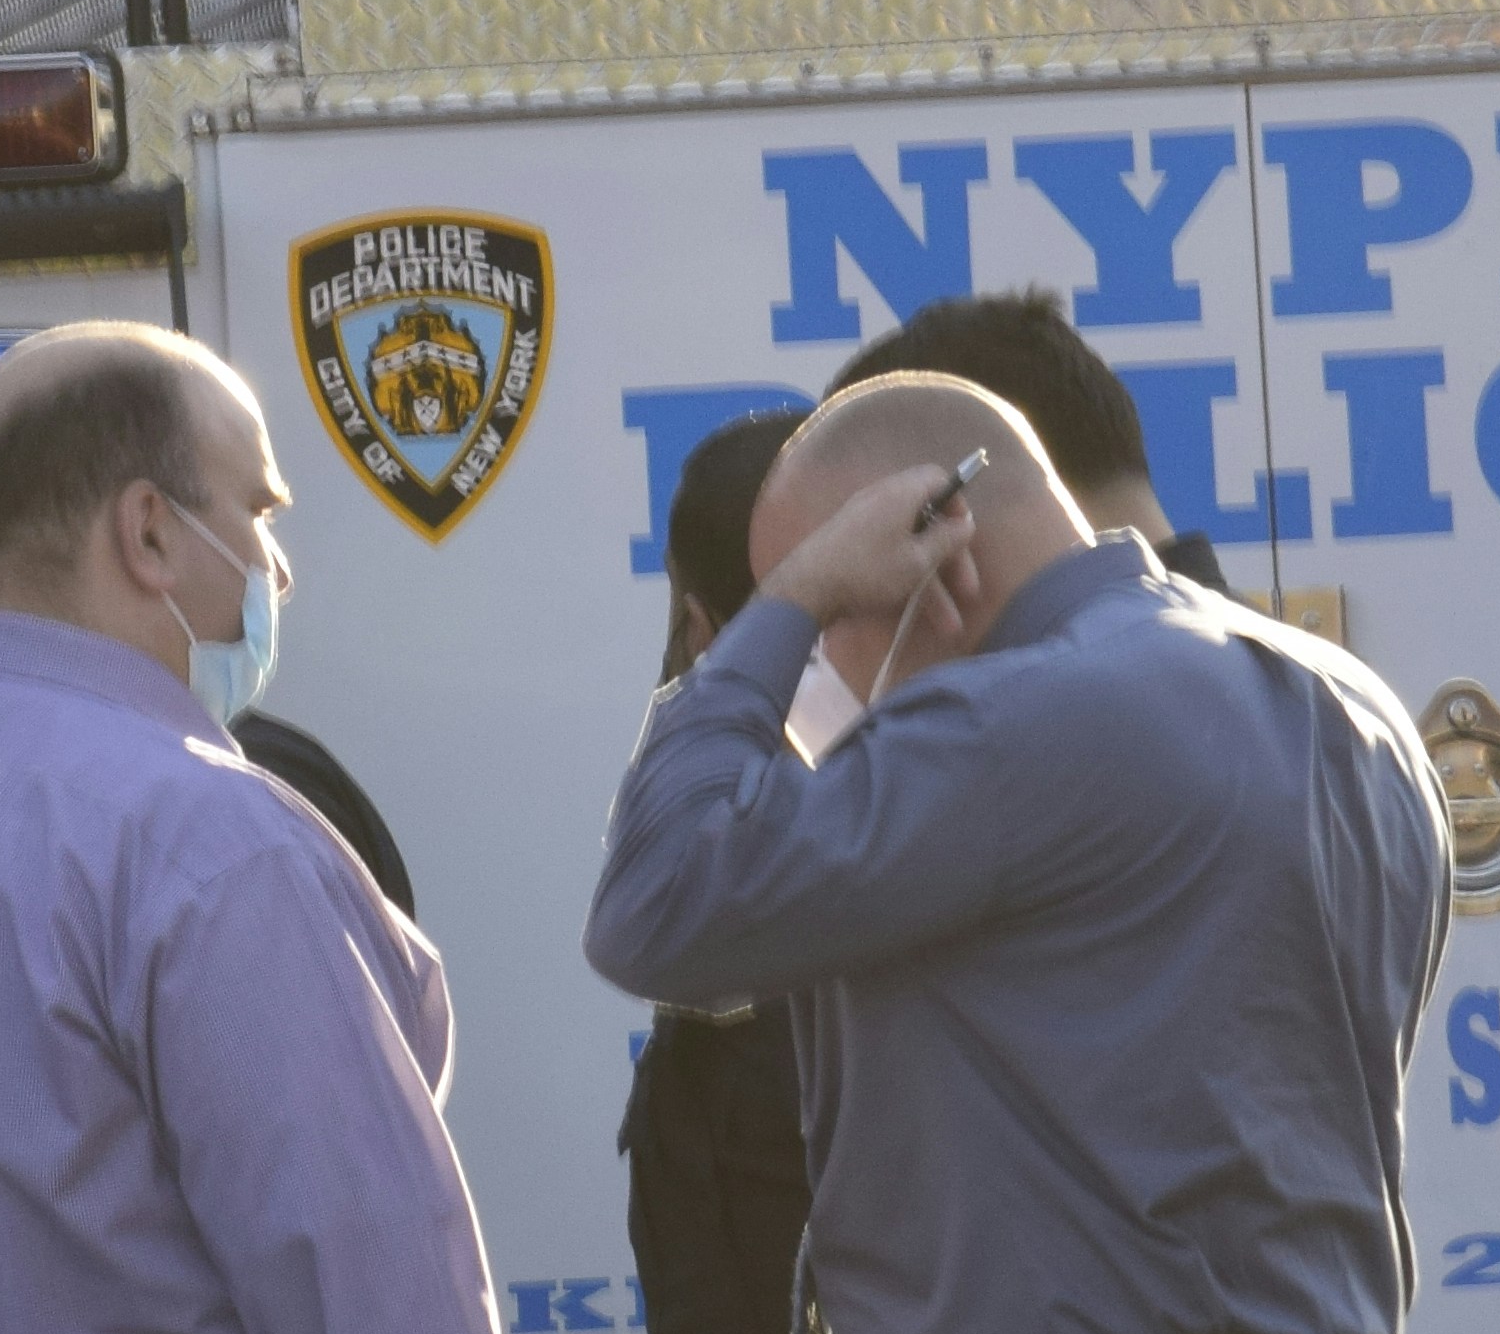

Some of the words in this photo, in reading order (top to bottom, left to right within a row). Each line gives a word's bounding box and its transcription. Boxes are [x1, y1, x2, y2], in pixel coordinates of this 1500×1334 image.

[308, 257, 538, 329] DEPARTMENT
[353, 223, 488, 267] POLICE
[315, 356, 368, 439] CITY
[362, 441, 407, 486] OF
[449, 422, 506, 499] NEW
[496, 327, 540, 420] YORK
